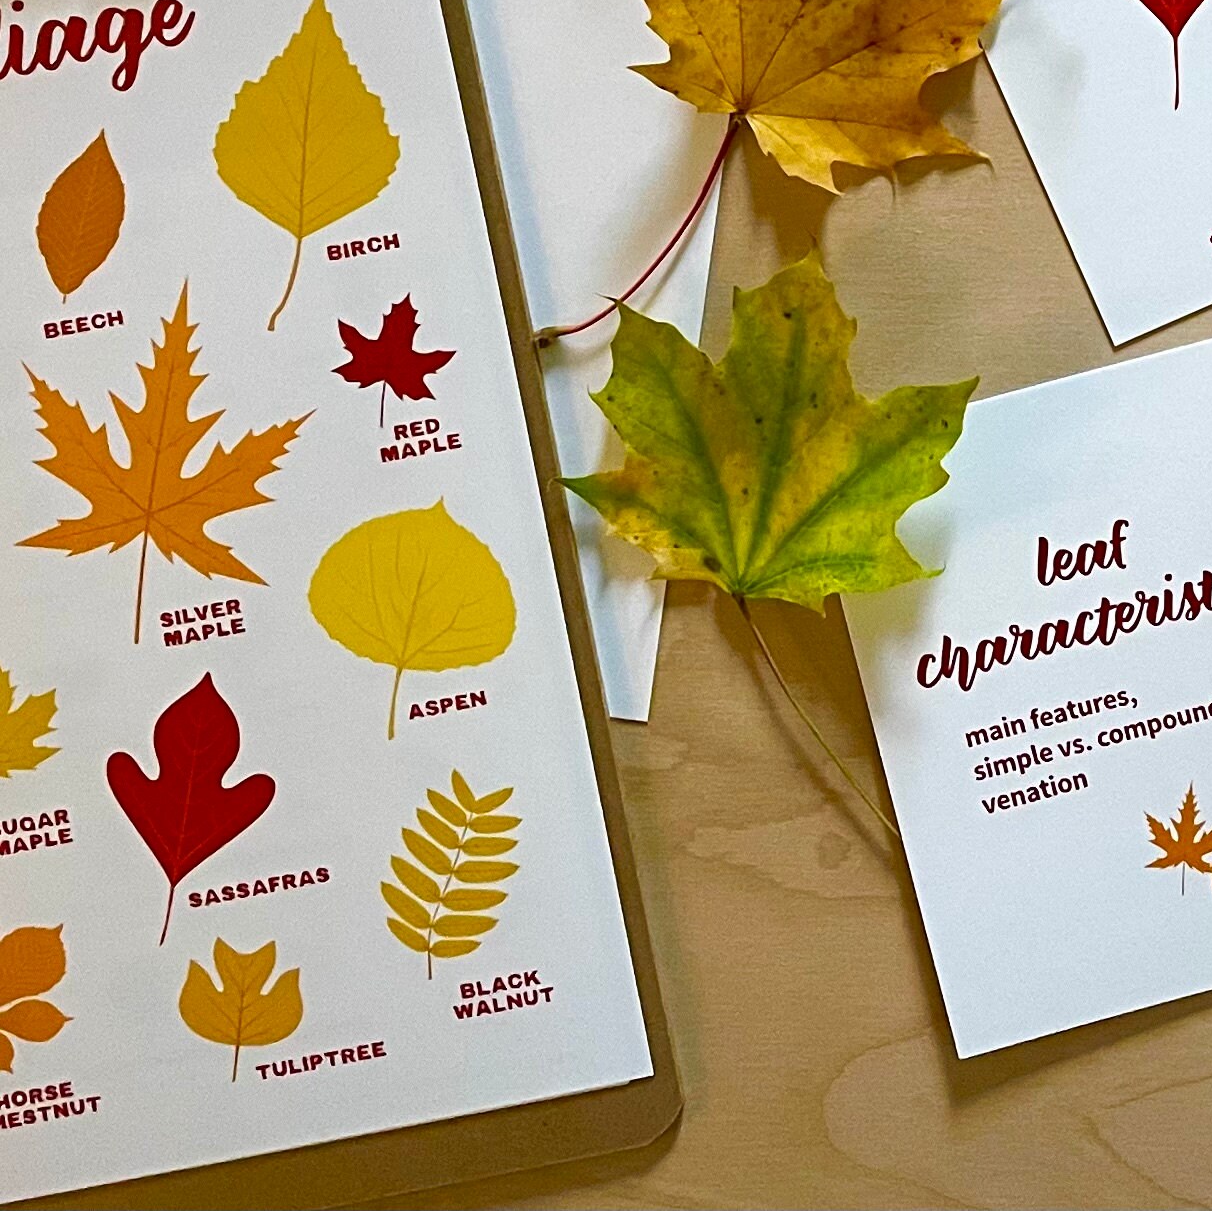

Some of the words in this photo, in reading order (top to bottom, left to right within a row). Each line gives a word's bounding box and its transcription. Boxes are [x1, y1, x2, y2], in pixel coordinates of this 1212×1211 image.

[327, 234, 400, 260] BIRCH
[44, 310, 124, 339] BEECH
[394, 419, 439, 440] RED
[380, 434, 462, 462] MAPLE
[1038, 520, 1129, 586] leaf
[160, 599, 241, 627] SILVER
[164, 618, 246, 646] MAPLE
[409, 691, 487, 720] ASPEN
[966, 717, 1026, 747] main
[1030, 691, 1137, 729] features,
[974, 745, 1053, 780] simple
[1057, 738, 1092, 757] vs.
[982, 773, 1088, 813] venation
[0, 810, 70, 835] UGAR
[189, 868, 329, 907] SASSAFRAS
[460, 970, 541, 999] BLACK
[453, 987, 553, 1019] WALNUT
[256, 1041, 387, 1079] TULIPTREE
